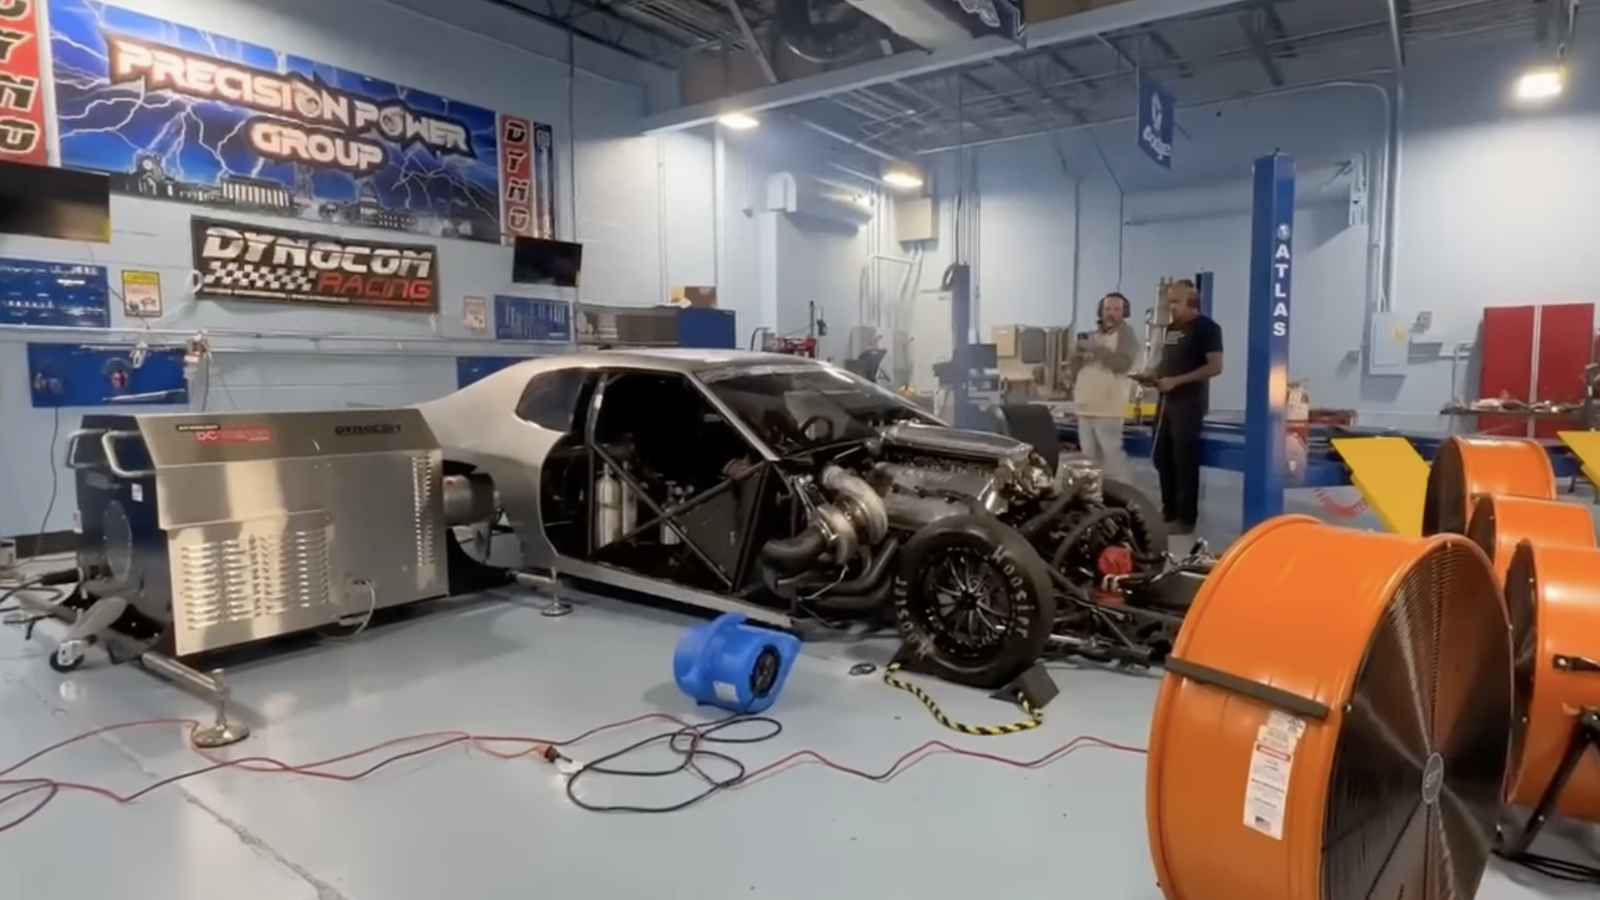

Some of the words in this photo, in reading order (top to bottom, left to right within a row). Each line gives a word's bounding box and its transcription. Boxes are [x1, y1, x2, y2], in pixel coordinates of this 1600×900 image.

[116, 39, 350, 127] PRECISION
[355, 100, 468, 151] POWER
[251, 122, 383, 171] GROUP
[503, 119, 531, 232] DYNO
[202, 226, 434, 279] DYNOCOM
[316, 271, 433, 299] RACING
[1273, 243, 1291, 337] ATLAS
